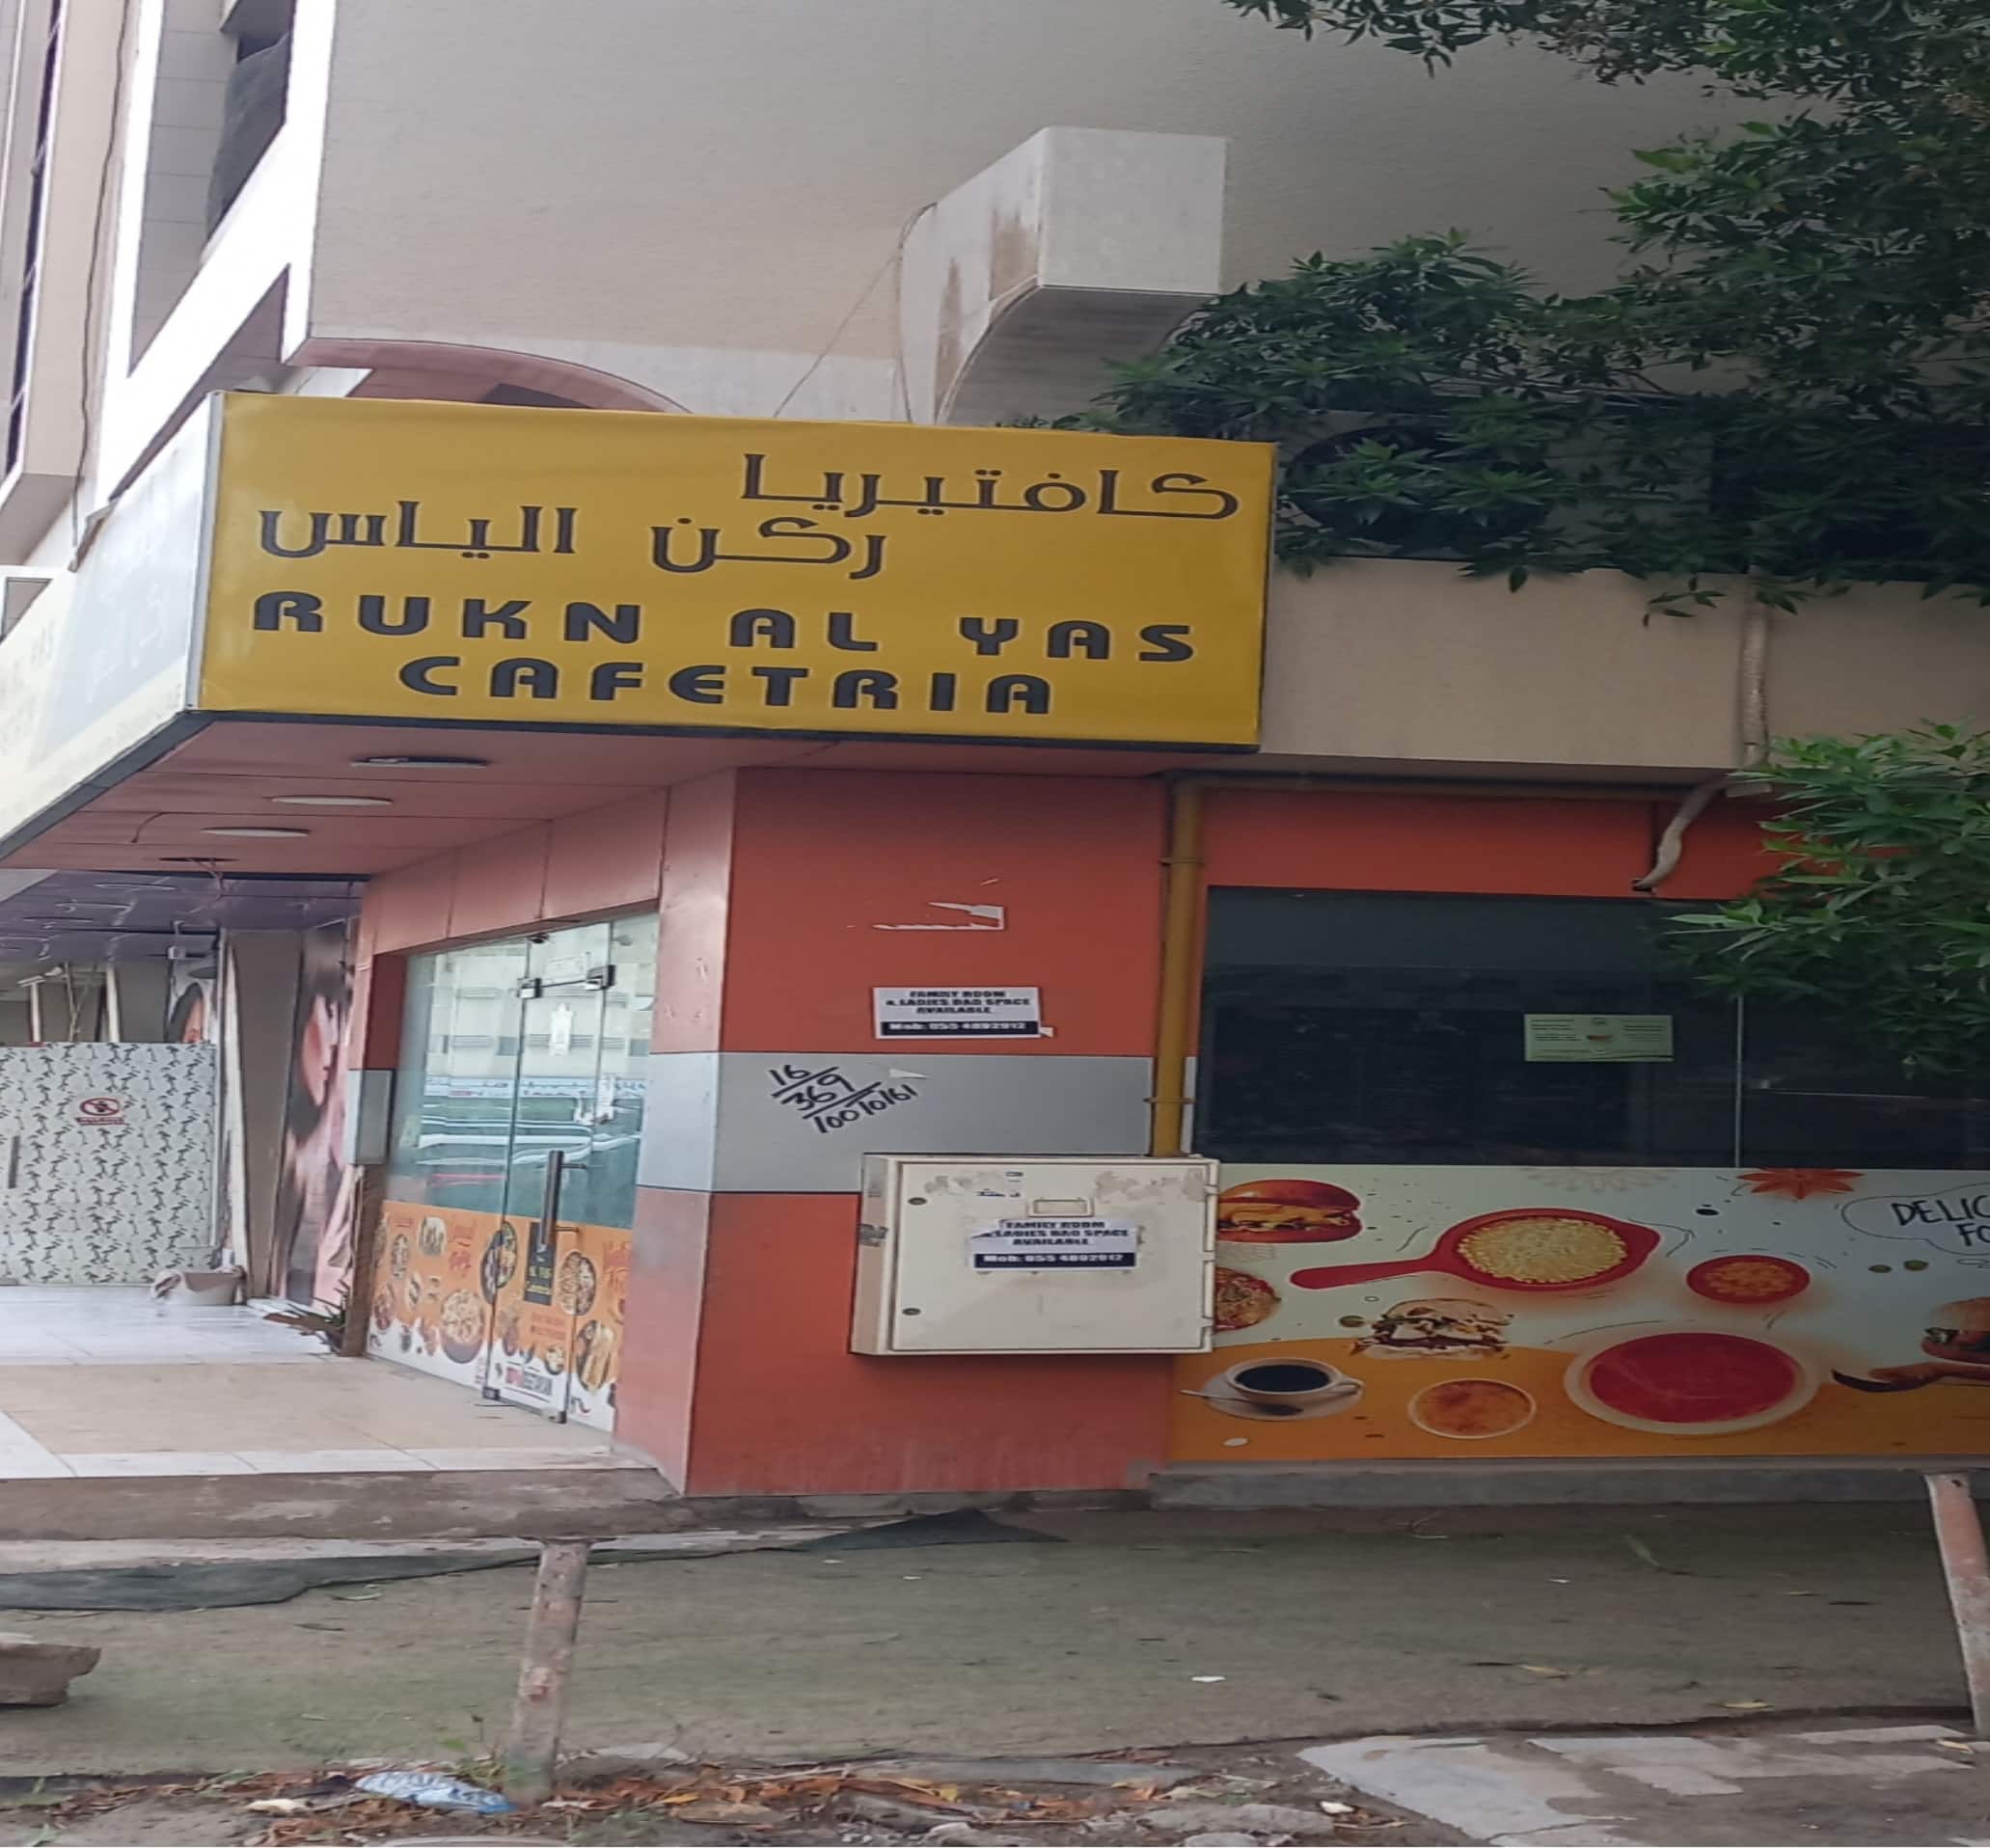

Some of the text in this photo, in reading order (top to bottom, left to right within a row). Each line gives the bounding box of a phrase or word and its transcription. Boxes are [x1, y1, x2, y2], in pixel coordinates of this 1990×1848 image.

[741, 453, 1240, 519] كافتيريا
[259, 501, 886, 579] ركن الياس
[253, 590, 1194, 662] RUKN AL YAS
[398, 656, 1051, 714] CAFETRIA
[769, 1064, 811, 1086] 16
[781, 1073, 856, 1111] 369
